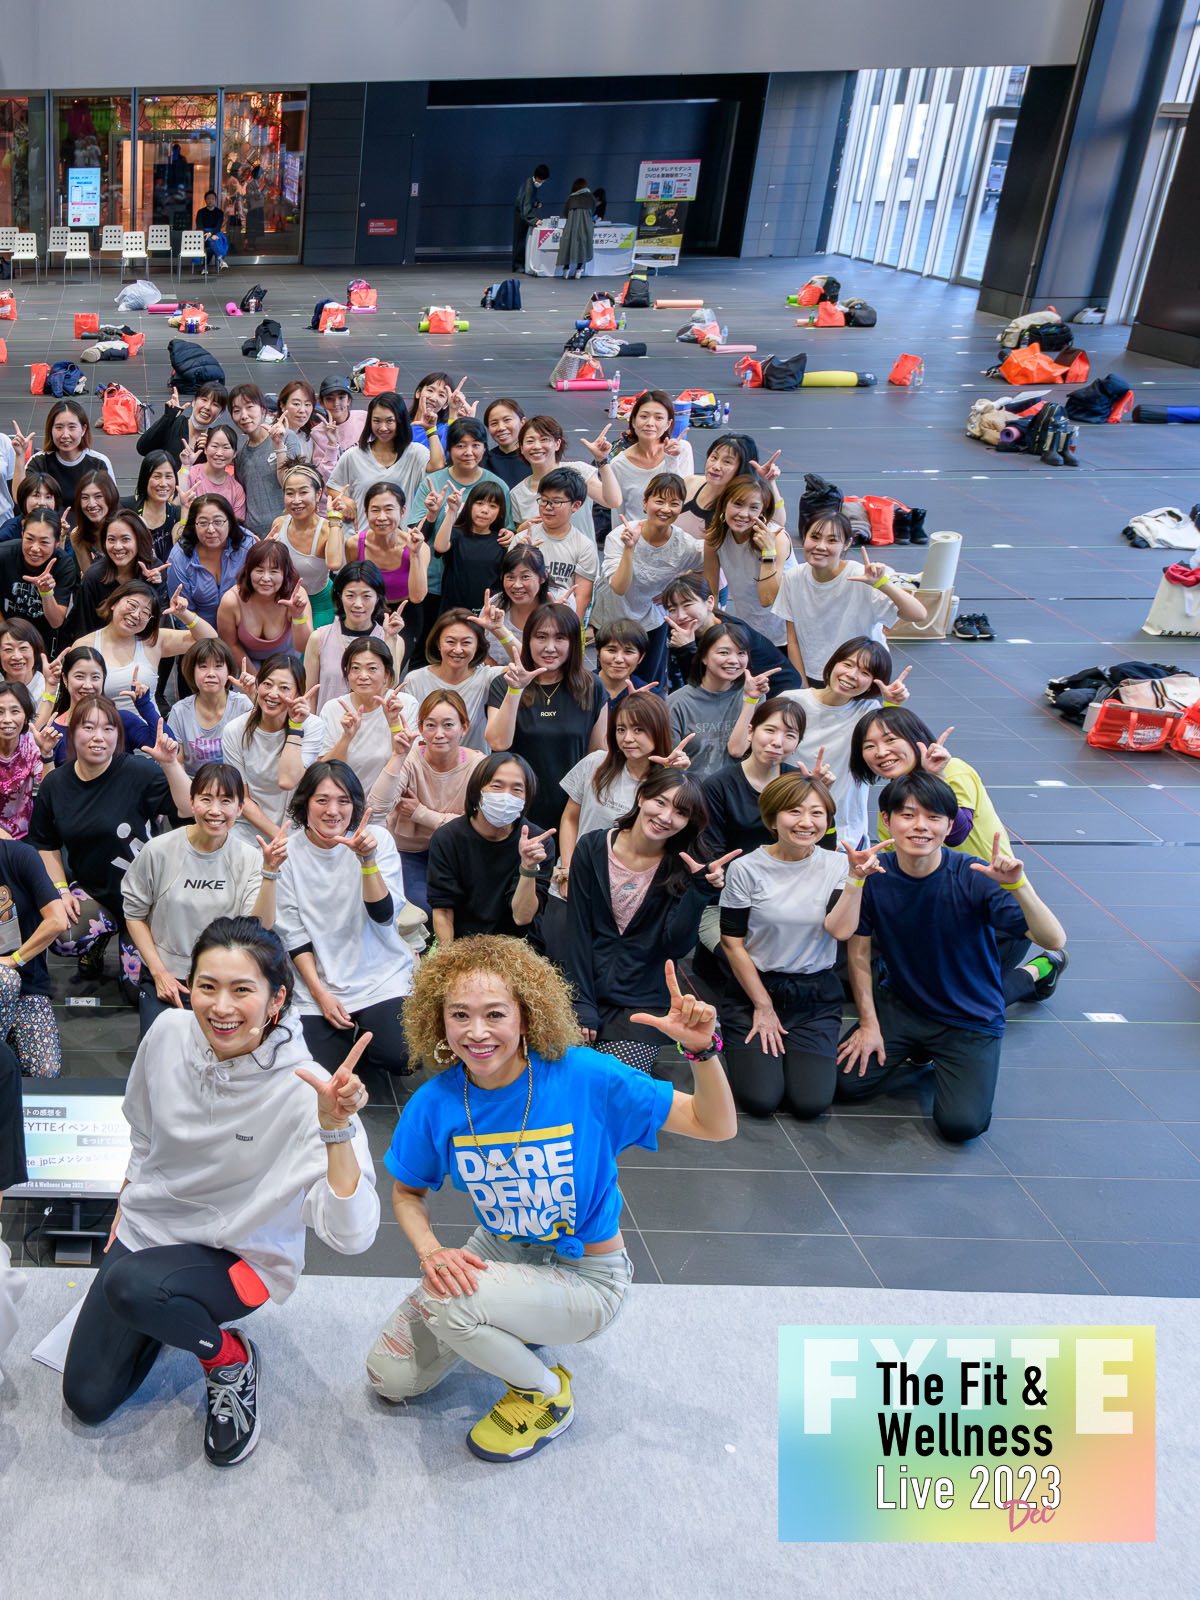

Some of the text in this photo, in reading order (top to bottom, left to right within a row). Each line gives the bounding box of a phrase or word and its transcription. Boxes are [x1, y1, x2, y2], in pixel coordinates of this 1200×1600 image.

[183, 879, 226, 890] NIKE
[23, 1109, 61, 1117] トの感想を
[455, 1140, 574, 1182] DARE
[466, 1175, 576, 1209] DEMO
[480, 1202, 577, 1237] DANCE
